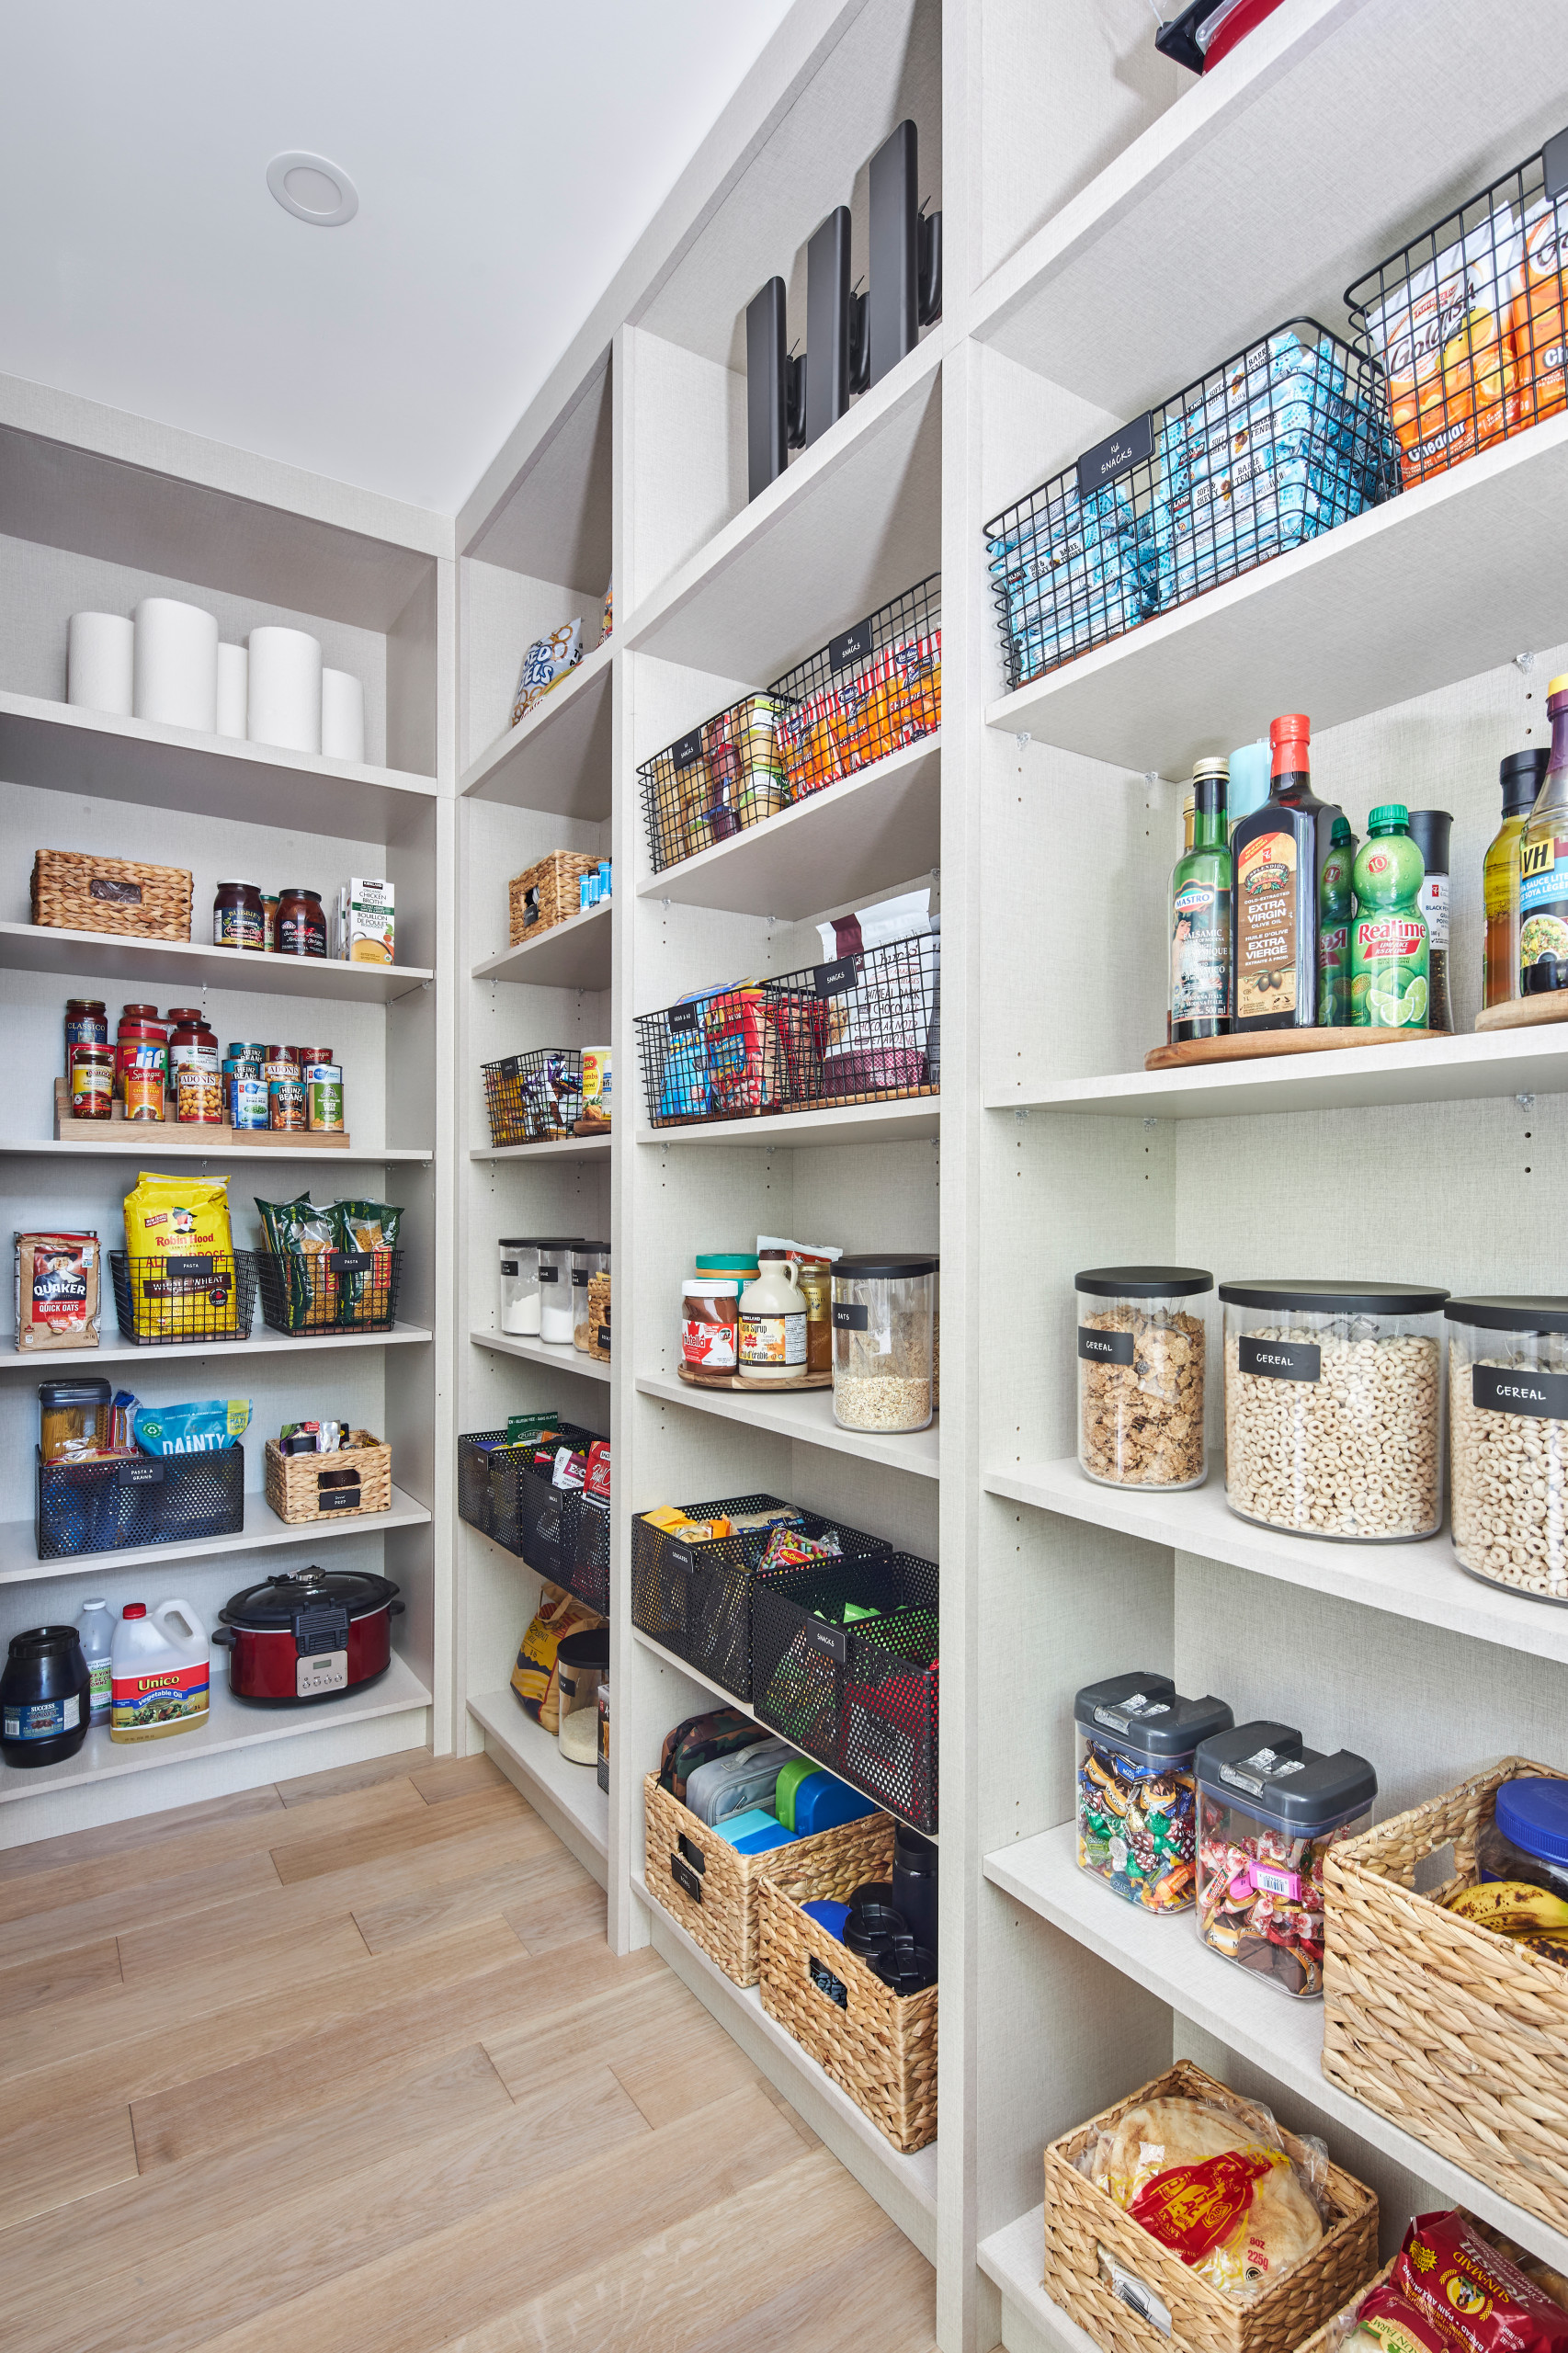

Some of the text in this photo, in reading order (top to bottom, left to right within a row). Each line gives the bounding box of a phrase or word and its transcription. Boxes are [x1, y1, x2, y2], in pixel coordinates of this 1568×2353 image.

[1391, 281, 1476, 375] Goldfish
[1248, 345, 1271, 367] BARRE
[1407, 420, 1467, 463] Cheddar
[1100, 447, 1132, 474] SNACKS
[1060, 542, 1079, 557] BARRE
[842, 643, 861, 658] SNACKS
[1369, 857, 1387, 871] 10
[1523, 843, 1549, 874] VH
[1249, 864, 1286, 878] SPLENDIDO
[1527, 876, 1550, 891] SAUCE
[358, 891, 387, 901] CHICKEN
[362, 897, 383, 905] BROTH
[1176, 892, 1210, 909] MASTRO
[1244, 891, 1290, 904] COLD-EXTRACTED
[1525, 888, 1541, 900] SOYA
[1248, 899, 1286, 914] EXTRA
[357, 912, 388, 921] BOUILLON
[1247, 908, 1287, 924] VIRGIN
[1251, 921, 1270, 929] OLIVE
[1183, 928, 1222, 941] BALSAMIC
[1244, 928, 1289, 942] HUILE D'OLIVE
[1248, 936, 1286, 950] EXTRA
[1245, 944, 1288, 960] VIERGE
[1244, 959, 1267, 967] EXTRAITE
[826, 972, 846, 983] SNACKS
[865, 988, 920, 1000] OATMEAL DARK
[873, 1003, 920, 1015] CHOCOLATE
[1205, 1006, 1226, 1015] 500 ml
[67, 1022, 106, 1031] CLASSICO
[854, 1020, 893, 1032] CHOCOLAT
[305, 1050, 330, 1061] Sprague
[131, 1069, 161, 1082] Sprague
[236, 1065, 256, 1074] HEINZ
[268, 1066, 300, 1074] ADONIS
[181, 1074, 215, 1086] ADONIS
[278, 1094, 303, 1102] BEANS
[155, 1233, 215, 1246] Robin Hood
[33, 1283, 86, 1297] QUAKER
[153, 1276, 223, 1291] WHOLE WHEAT
[39, 1304, 61, 1313] QUICK
[62, 1303, 79, 1313] OATS
[837, 1313, 850, 1321] OATS
[750, 1324, 767, 1335] Syrup
[684, 1334, 706, 1348] nutella
[1085, 1340, 1113, 1352] CEREAL
[747, 1349, 768, 1359] d'érable
[1256, 1352, 1294, 1367] CEREAL
[1496, 1384, 1547, 1401] CEREAL
[816, 1632, 835, 1647] SNACKS
[138, 1676, 180, 1692] Unico
[138, 1689, 183, 1706] Vegetable Oil
[30, 1702, 55, 1712] SUCCESS
[1105, 1786, 1124, 1811] MAGIC
[1210, 1873, 1226, 1901] ROCKETS
[1247, 2249, 1269, 2271] 225g
[1460, 2237, 1529, 2309] Raisin
[1402, 2264, 1485, 2351] BREAD PAIN AUX RAISINS
[1372, 2318, 1398, 2337] FARM
